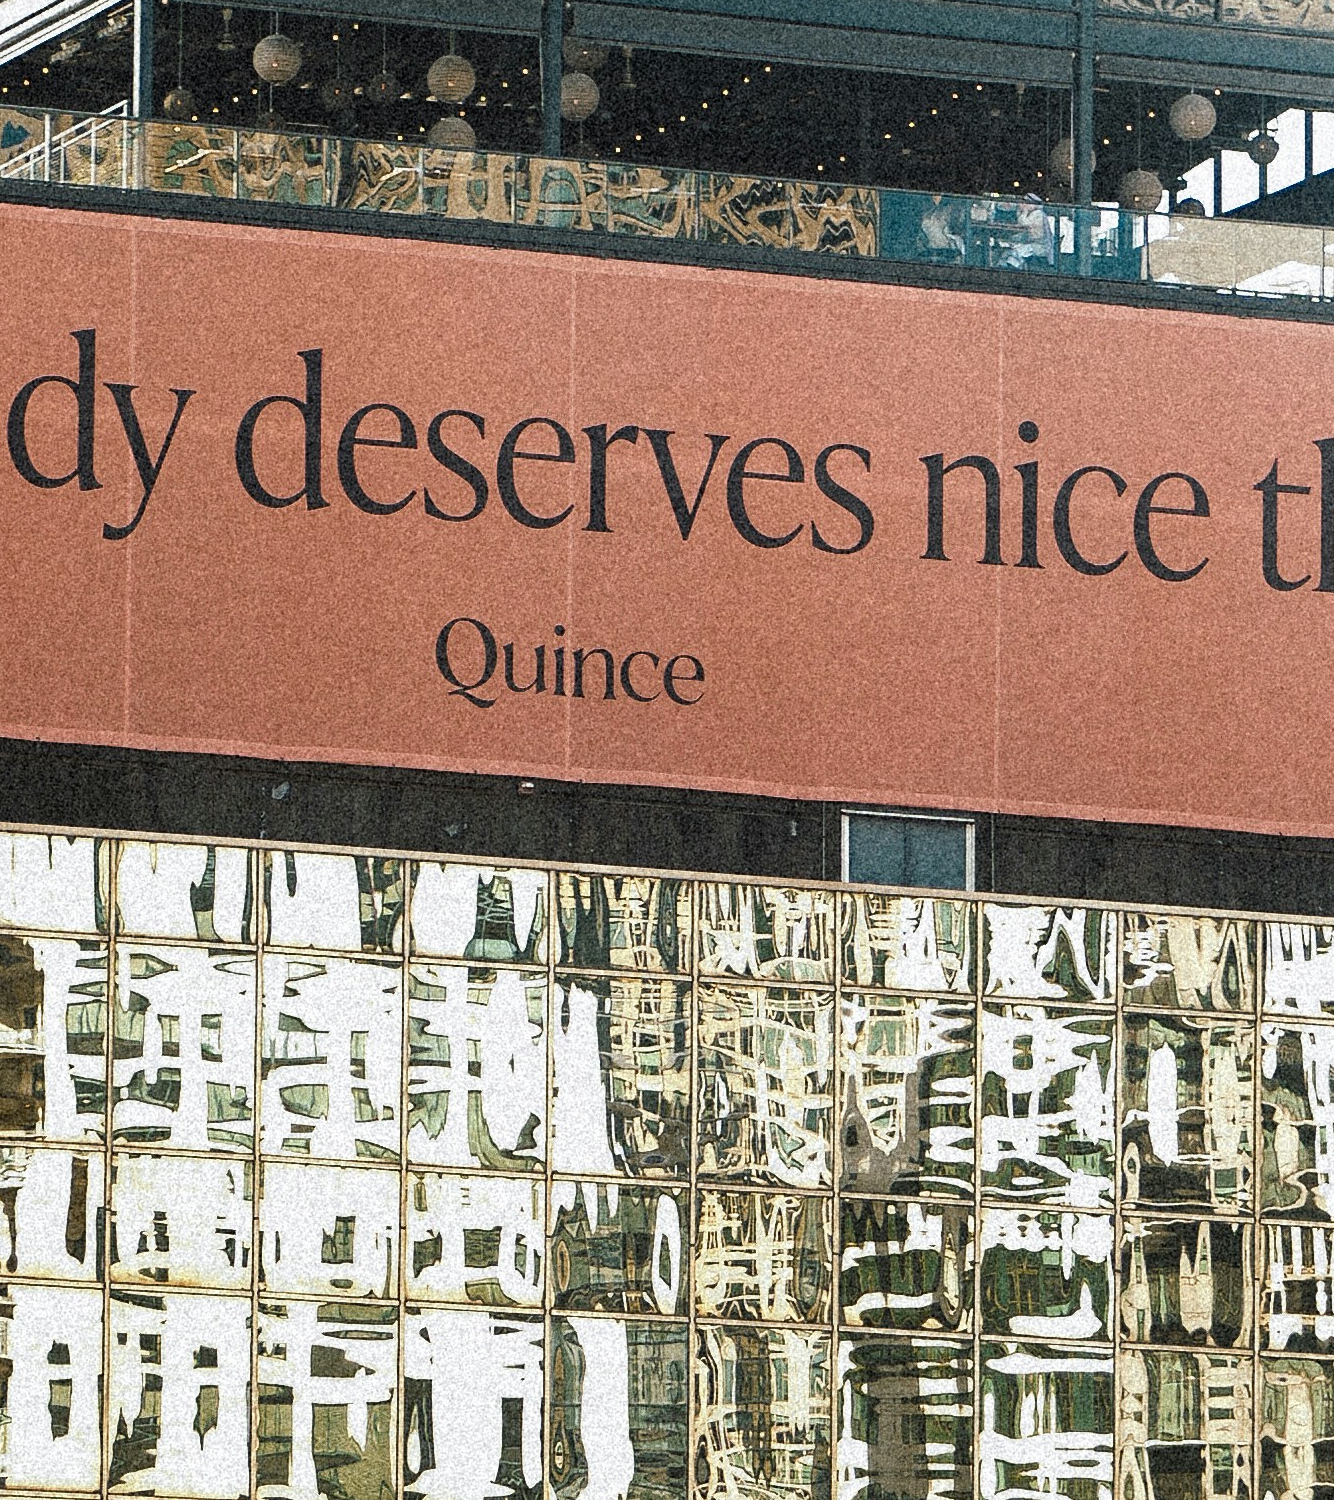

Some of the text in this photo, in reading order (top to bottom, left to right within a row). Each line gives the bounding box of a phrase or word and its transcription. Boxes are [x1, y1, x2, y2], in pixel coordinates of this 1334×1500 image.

[234, 348, 875, 556] deserves
[920, 421, 1210, 582] nice
[435, 616, 707, 710] Quince
